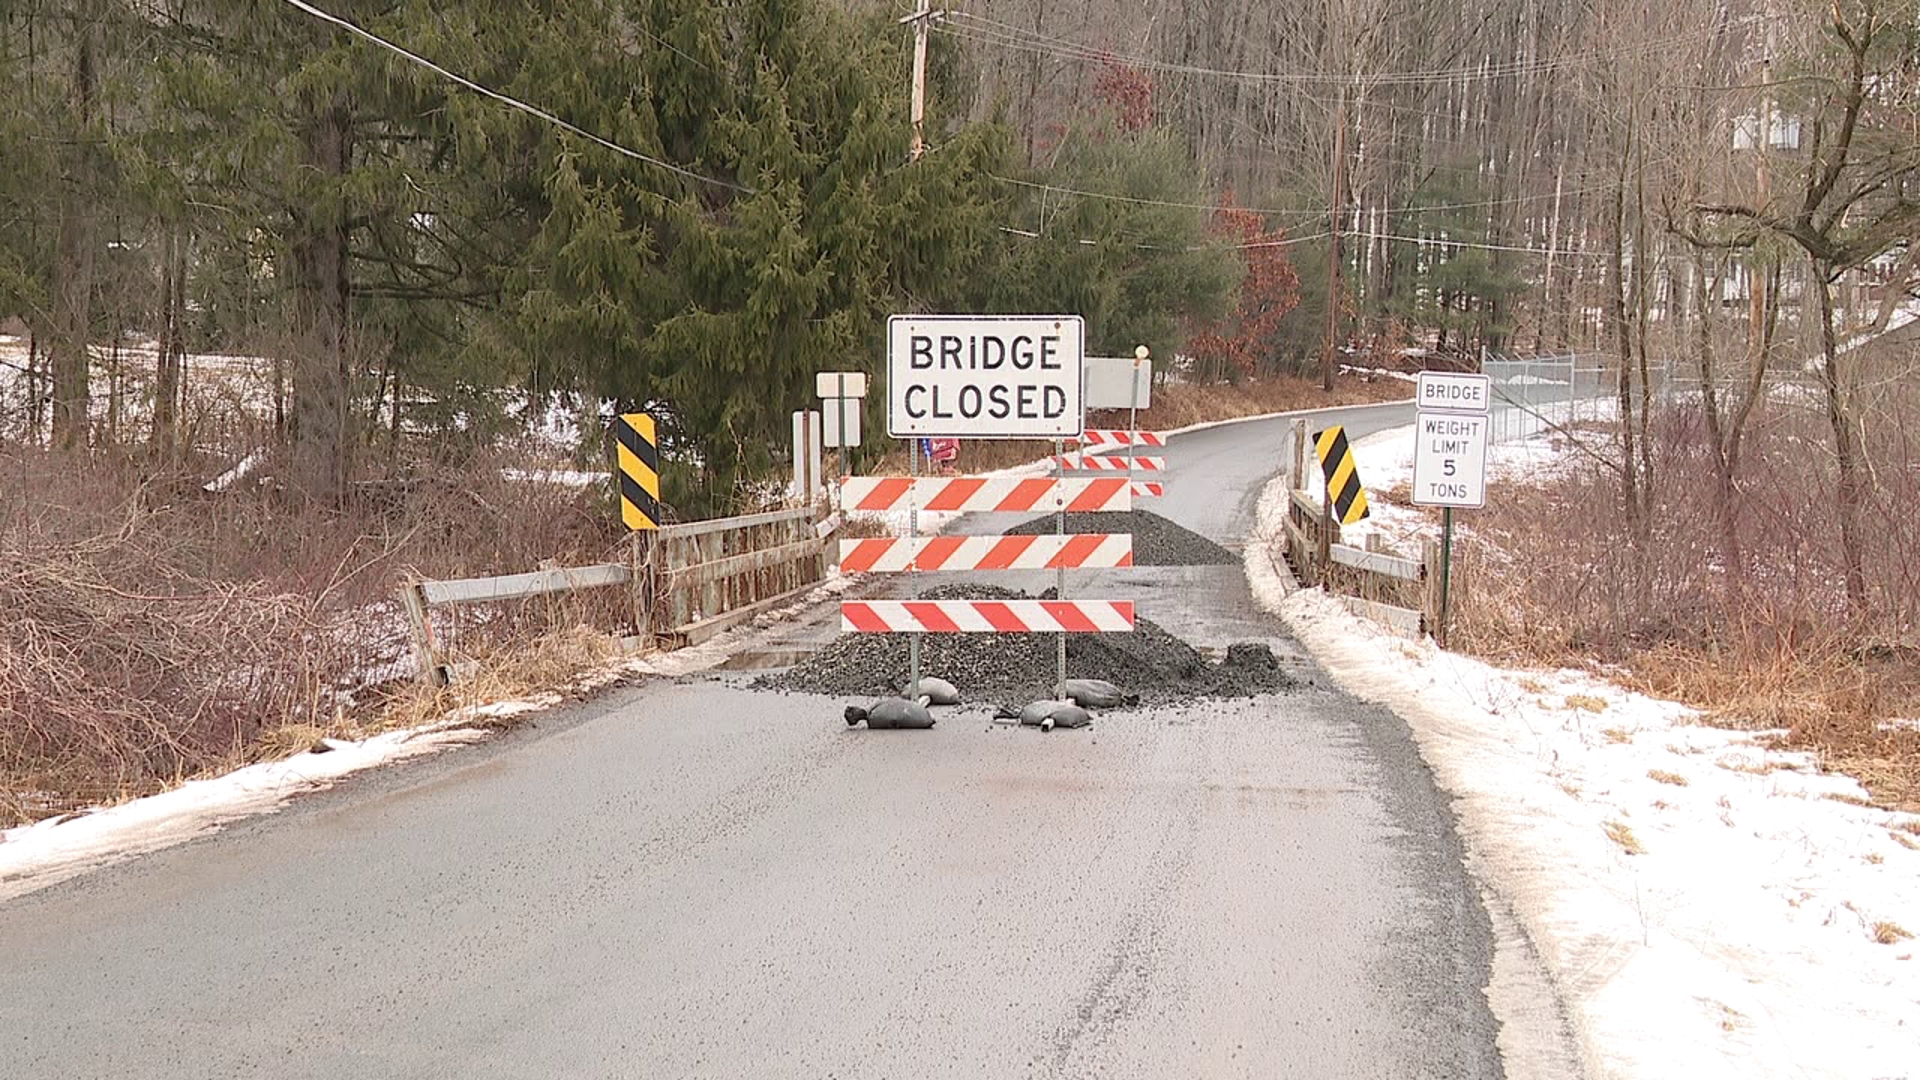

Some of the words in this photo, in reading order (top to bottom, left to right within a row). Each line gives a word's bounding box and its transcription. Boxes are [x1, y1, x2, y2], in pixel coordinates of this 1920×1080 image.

[910, 336, 1061, 370] BRIDGE
[1426, 383, 1481, 400] BRIDGE
[905, 384, 1067, 419] CLOSED
[1425, 420, 1480, 436] WEIGHT
[1432, 440, 1469, 454] LIMIT
[1443, 459, 1456, 476] 5
[1430, 483, 1467, 498] TONS
